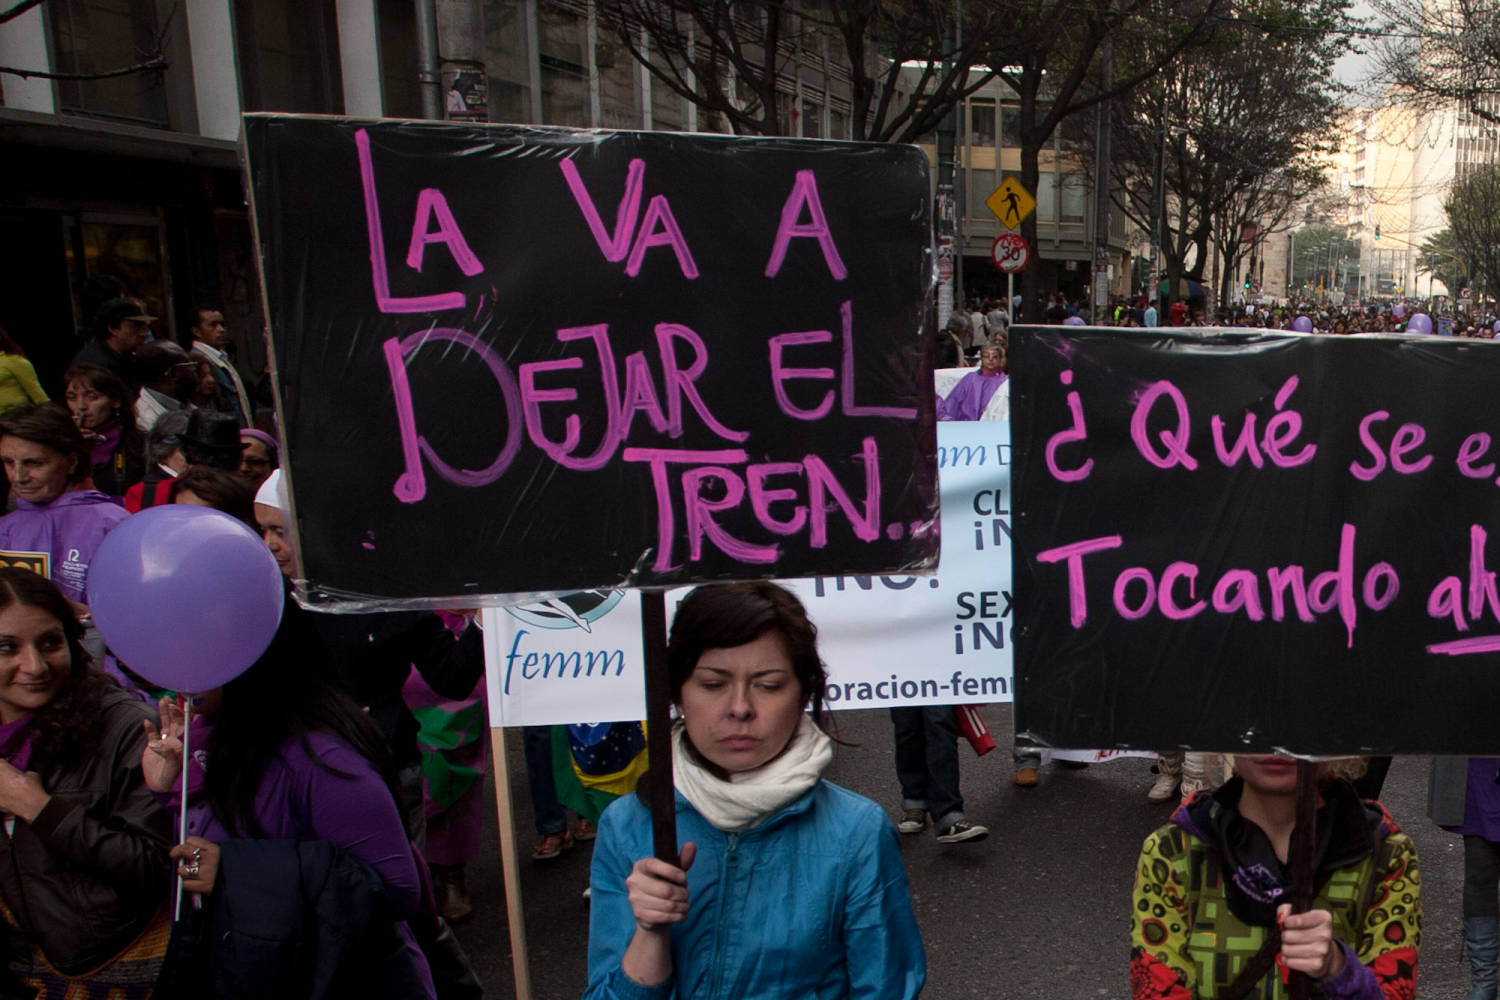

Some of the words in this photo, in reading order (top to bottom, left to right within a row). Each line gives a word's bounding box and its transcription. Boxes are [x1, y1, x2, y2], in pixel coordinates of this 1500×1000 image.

[355, 128, 485, 313] LA
[560, 157, 700, 280] VA
[765, 169, 848, 280] A
[383, 322, 750, 503] DEJAR
[770, 302, 917, 421] EL
[1349, 410, 1434, 481] se
[973, 489, 1009, 516] CL
[956, 590, 1013, 620] SEX
[1037, 523, 1401, 649] Tocando
[504, 629, 626, 696] femm
[826, 670, 1014, 702] oracion-fem
